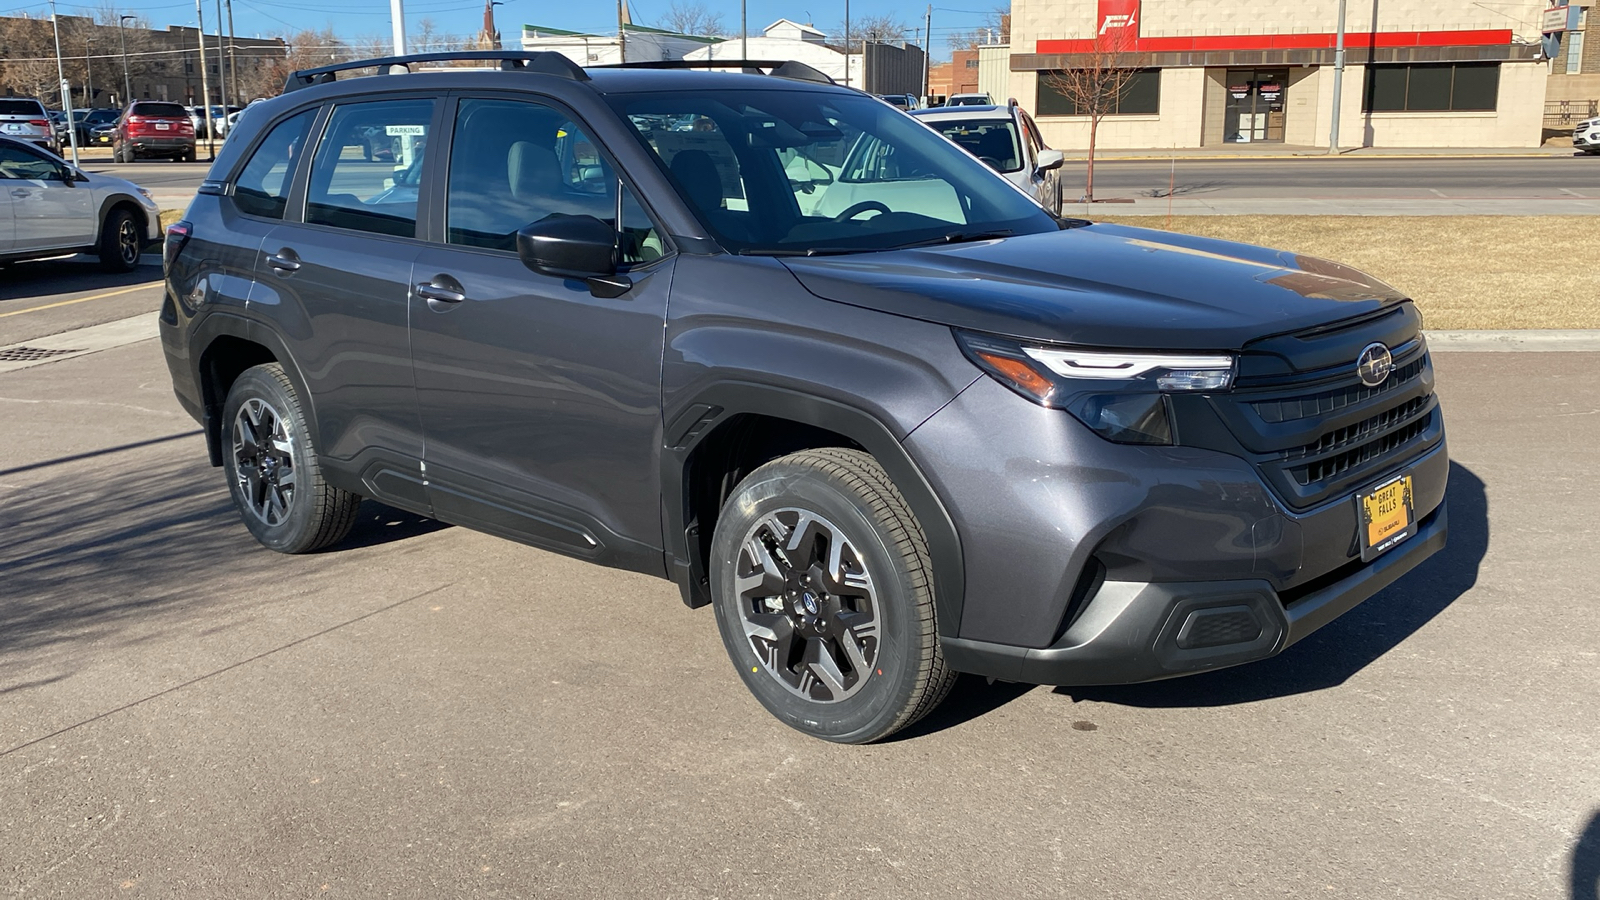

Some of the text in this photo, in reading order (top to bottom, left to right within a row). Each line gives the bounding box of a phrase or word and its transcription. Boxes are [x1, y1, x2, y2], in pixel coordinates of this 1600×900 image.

[1378, 487, 1396, 504] GREAT
[1378, 499, 1397, 517] FALLS
[1383, 519, 1400, 532] SUBARU
